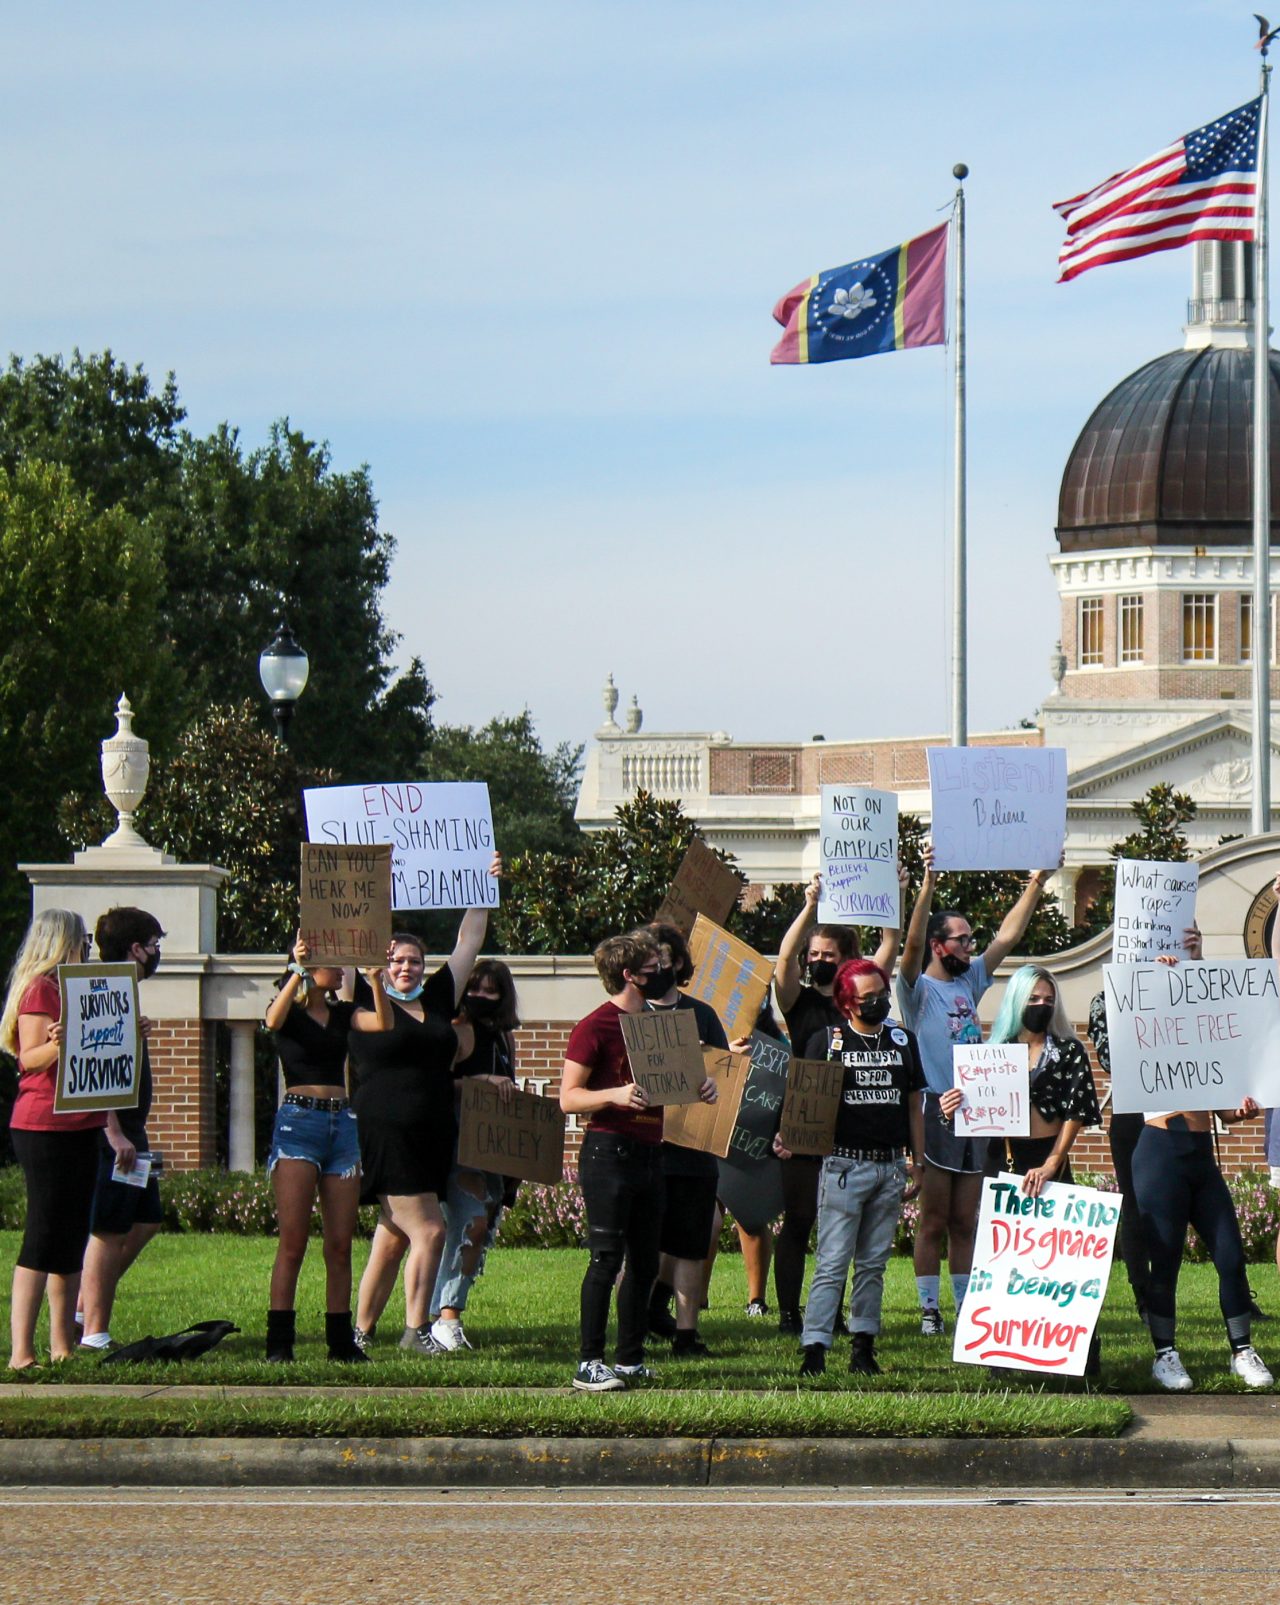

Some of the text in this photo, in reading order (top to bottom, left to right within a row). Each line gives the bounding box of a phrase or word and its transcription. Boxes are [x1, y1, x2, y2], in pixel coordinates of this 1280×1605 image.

[933, 749, 1055, 794] Listen!
[363, 784, 423, 816] END
[833, 795, 882, 815] NOT ON
[841, 817, 873, 832] OUR
[307, 849, 376, 874] CAN YOU
[823, 836, 893, 860] CAMPUS!
[309, 880, 376, 900] HEAR ME
[1121, 863, 1198, 893] What causes
[331, 902, 370, 919] NOW?
[830, 892, 895, 916] SURVIVORS
[1140, 893, 1182, 917] rape?
[1107, 967, 1279, 1013] WE DESERVE A
[81, 991, 130, 1021] SURVIVORS
[625, 1014, 689, 1052] JUSTICE
[1134, 1013, 1243, 1049] RAPE FREE
[648, 1053, 666, 1067] FOR
[842, 1051, 902, 1066] FEMINISM
[68, 1054, 134, 1095] SURVIVORS
[788, 1061, 842, 1098] JUSTICE
[856, 1070, 891, 1085] IS FOR
[1140, 1060, 1225, 1094] CAMPUS
[845, 1089, 900, 1104] EVERYBODY
[989, 1183, 1119, 1228] There is no
[989, 1219, 1109, 1270] Disgrace
[970, 1267, 993, 1294] in
[1007, 1267, 1078, 1307] being
[965, 1306, 1088, 1353] Survivor
